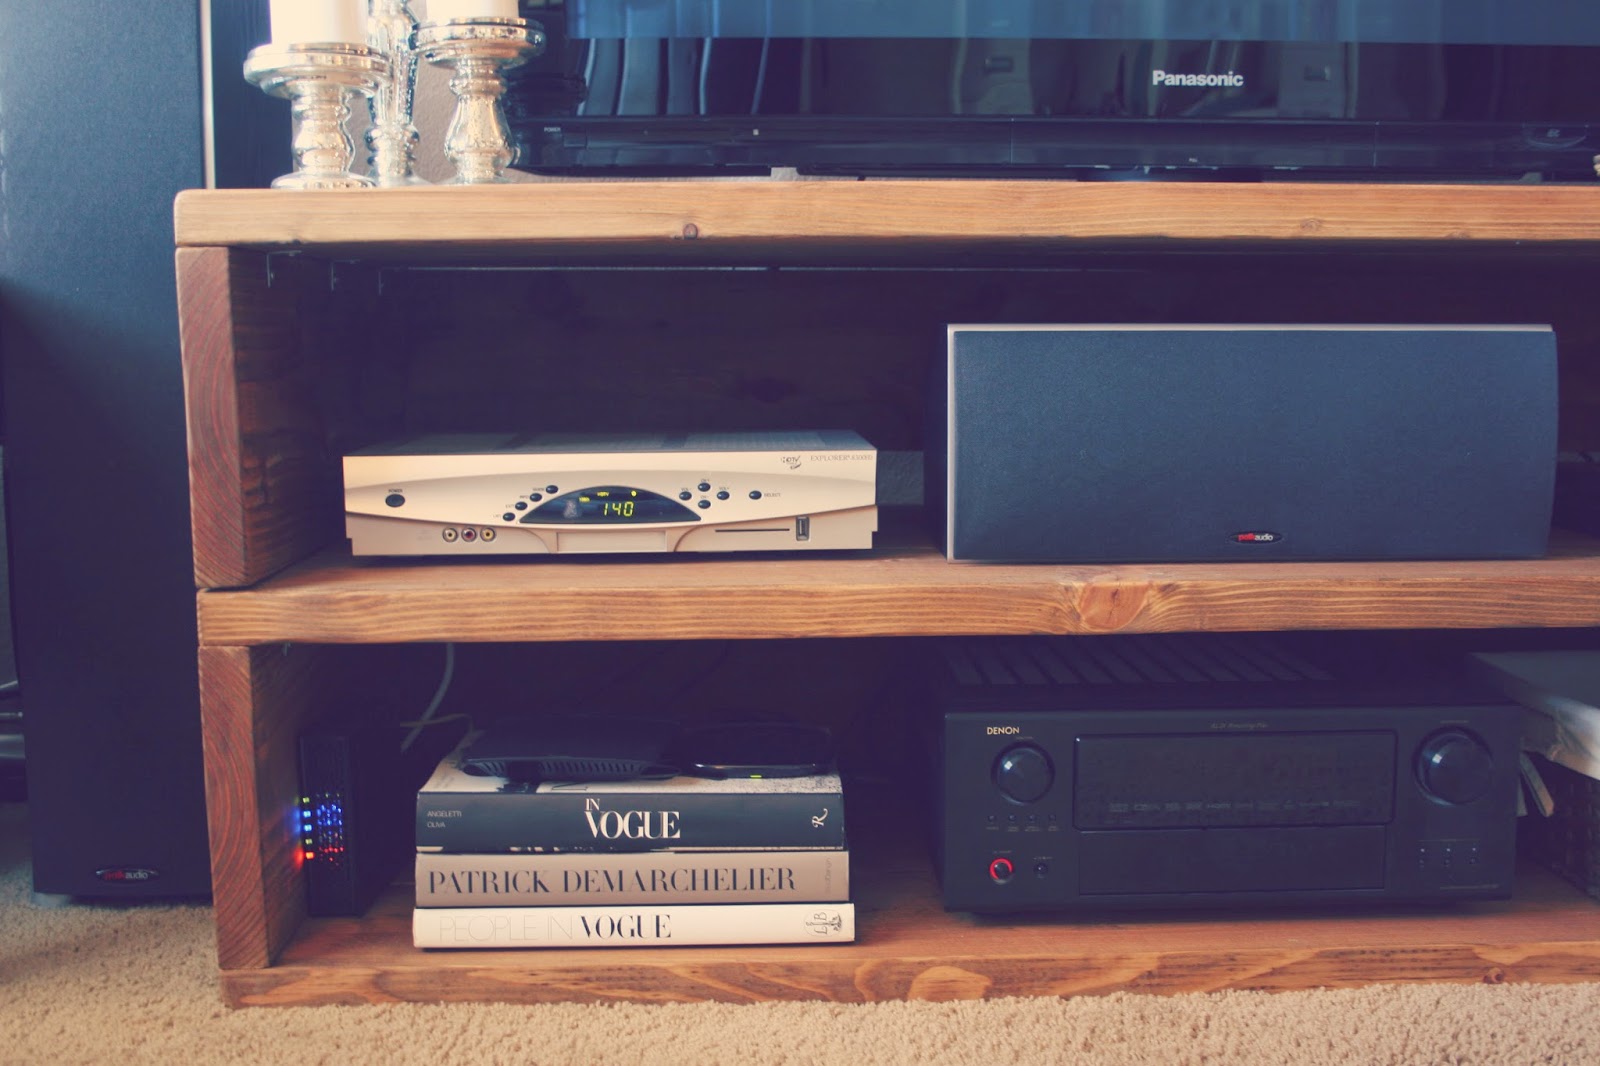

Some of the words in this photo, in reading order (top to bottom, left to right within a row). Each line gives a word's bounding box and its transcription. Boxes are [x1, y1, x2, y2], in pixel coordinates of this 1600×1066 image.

[1152, 69, 1244, 87] Panasonic
[603, 501, 635, 517] 140
[986, 726, 1020, 736] DENON
[584, 797, 601, 811] IN
[426, 809, 462, 818] ANGELETTI
[426, 821, 446, 829] OLIVA
[584, 810, 681, 840] VOGUE
[429, 869, 551, 895] PATRICK
[563, 867, 796, 894] DEMARCHELIER
[439, 914, 537, 943] PEOPLE
[547, 914, 573, 942] IN
[580, 913, 672, 940] VOGUE
